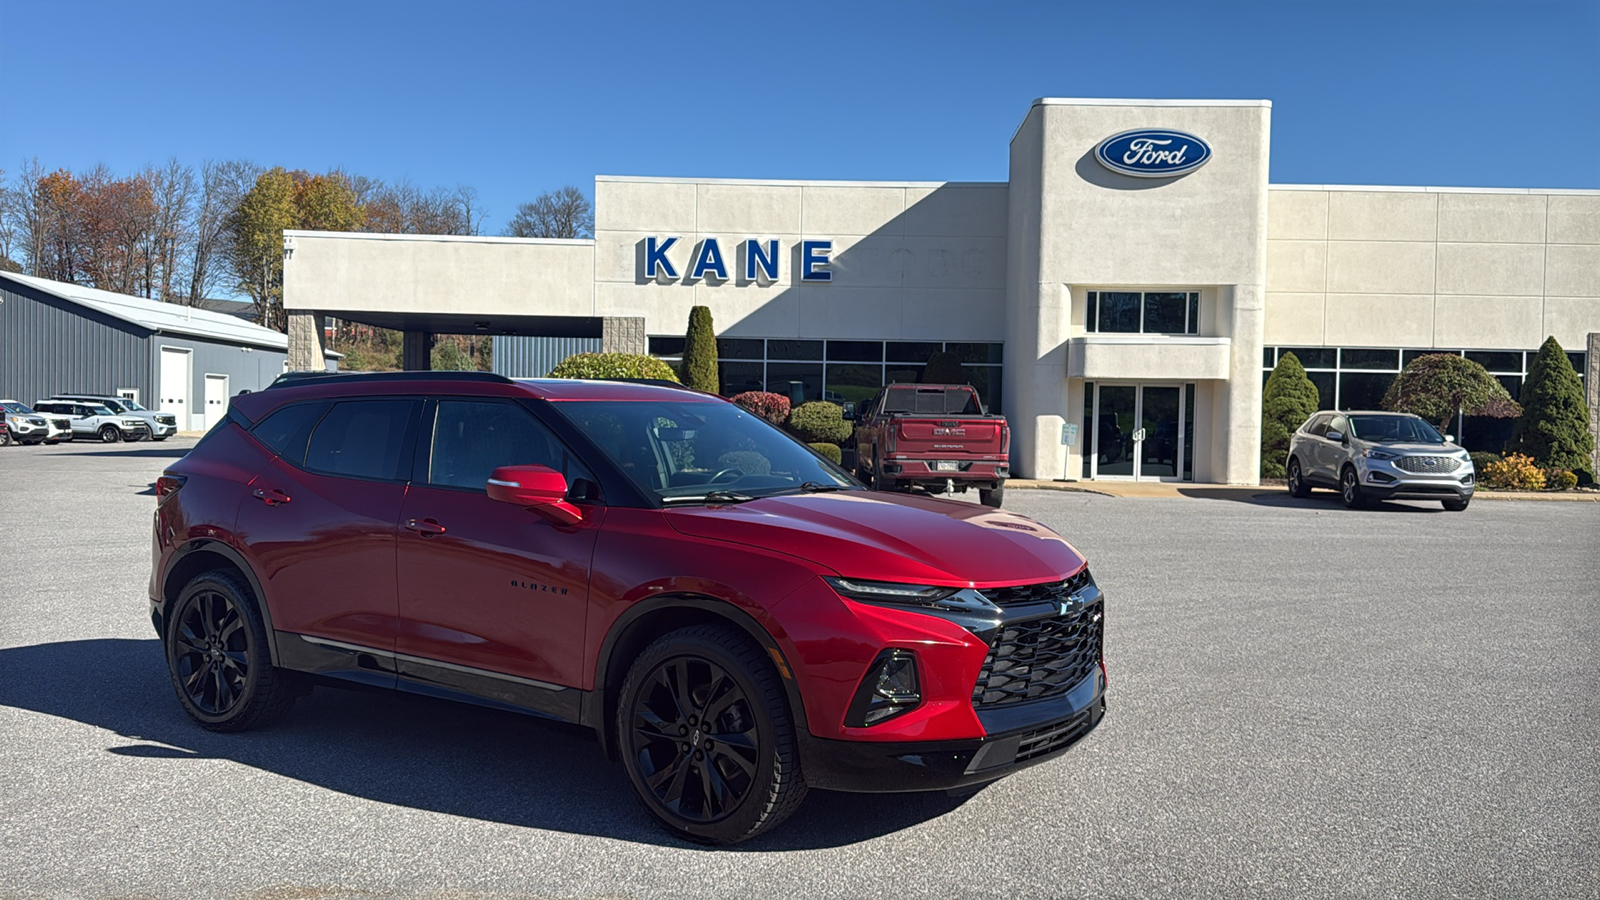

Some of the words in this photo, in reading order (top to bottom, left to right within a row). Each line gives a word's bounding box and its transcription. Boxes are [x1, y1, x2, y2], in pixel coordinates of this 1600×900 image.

[1123, 138, 1188, 165] Ford
[644, 235, 833, 282] KANE
[510, 580, 568, 596] BLAZER
